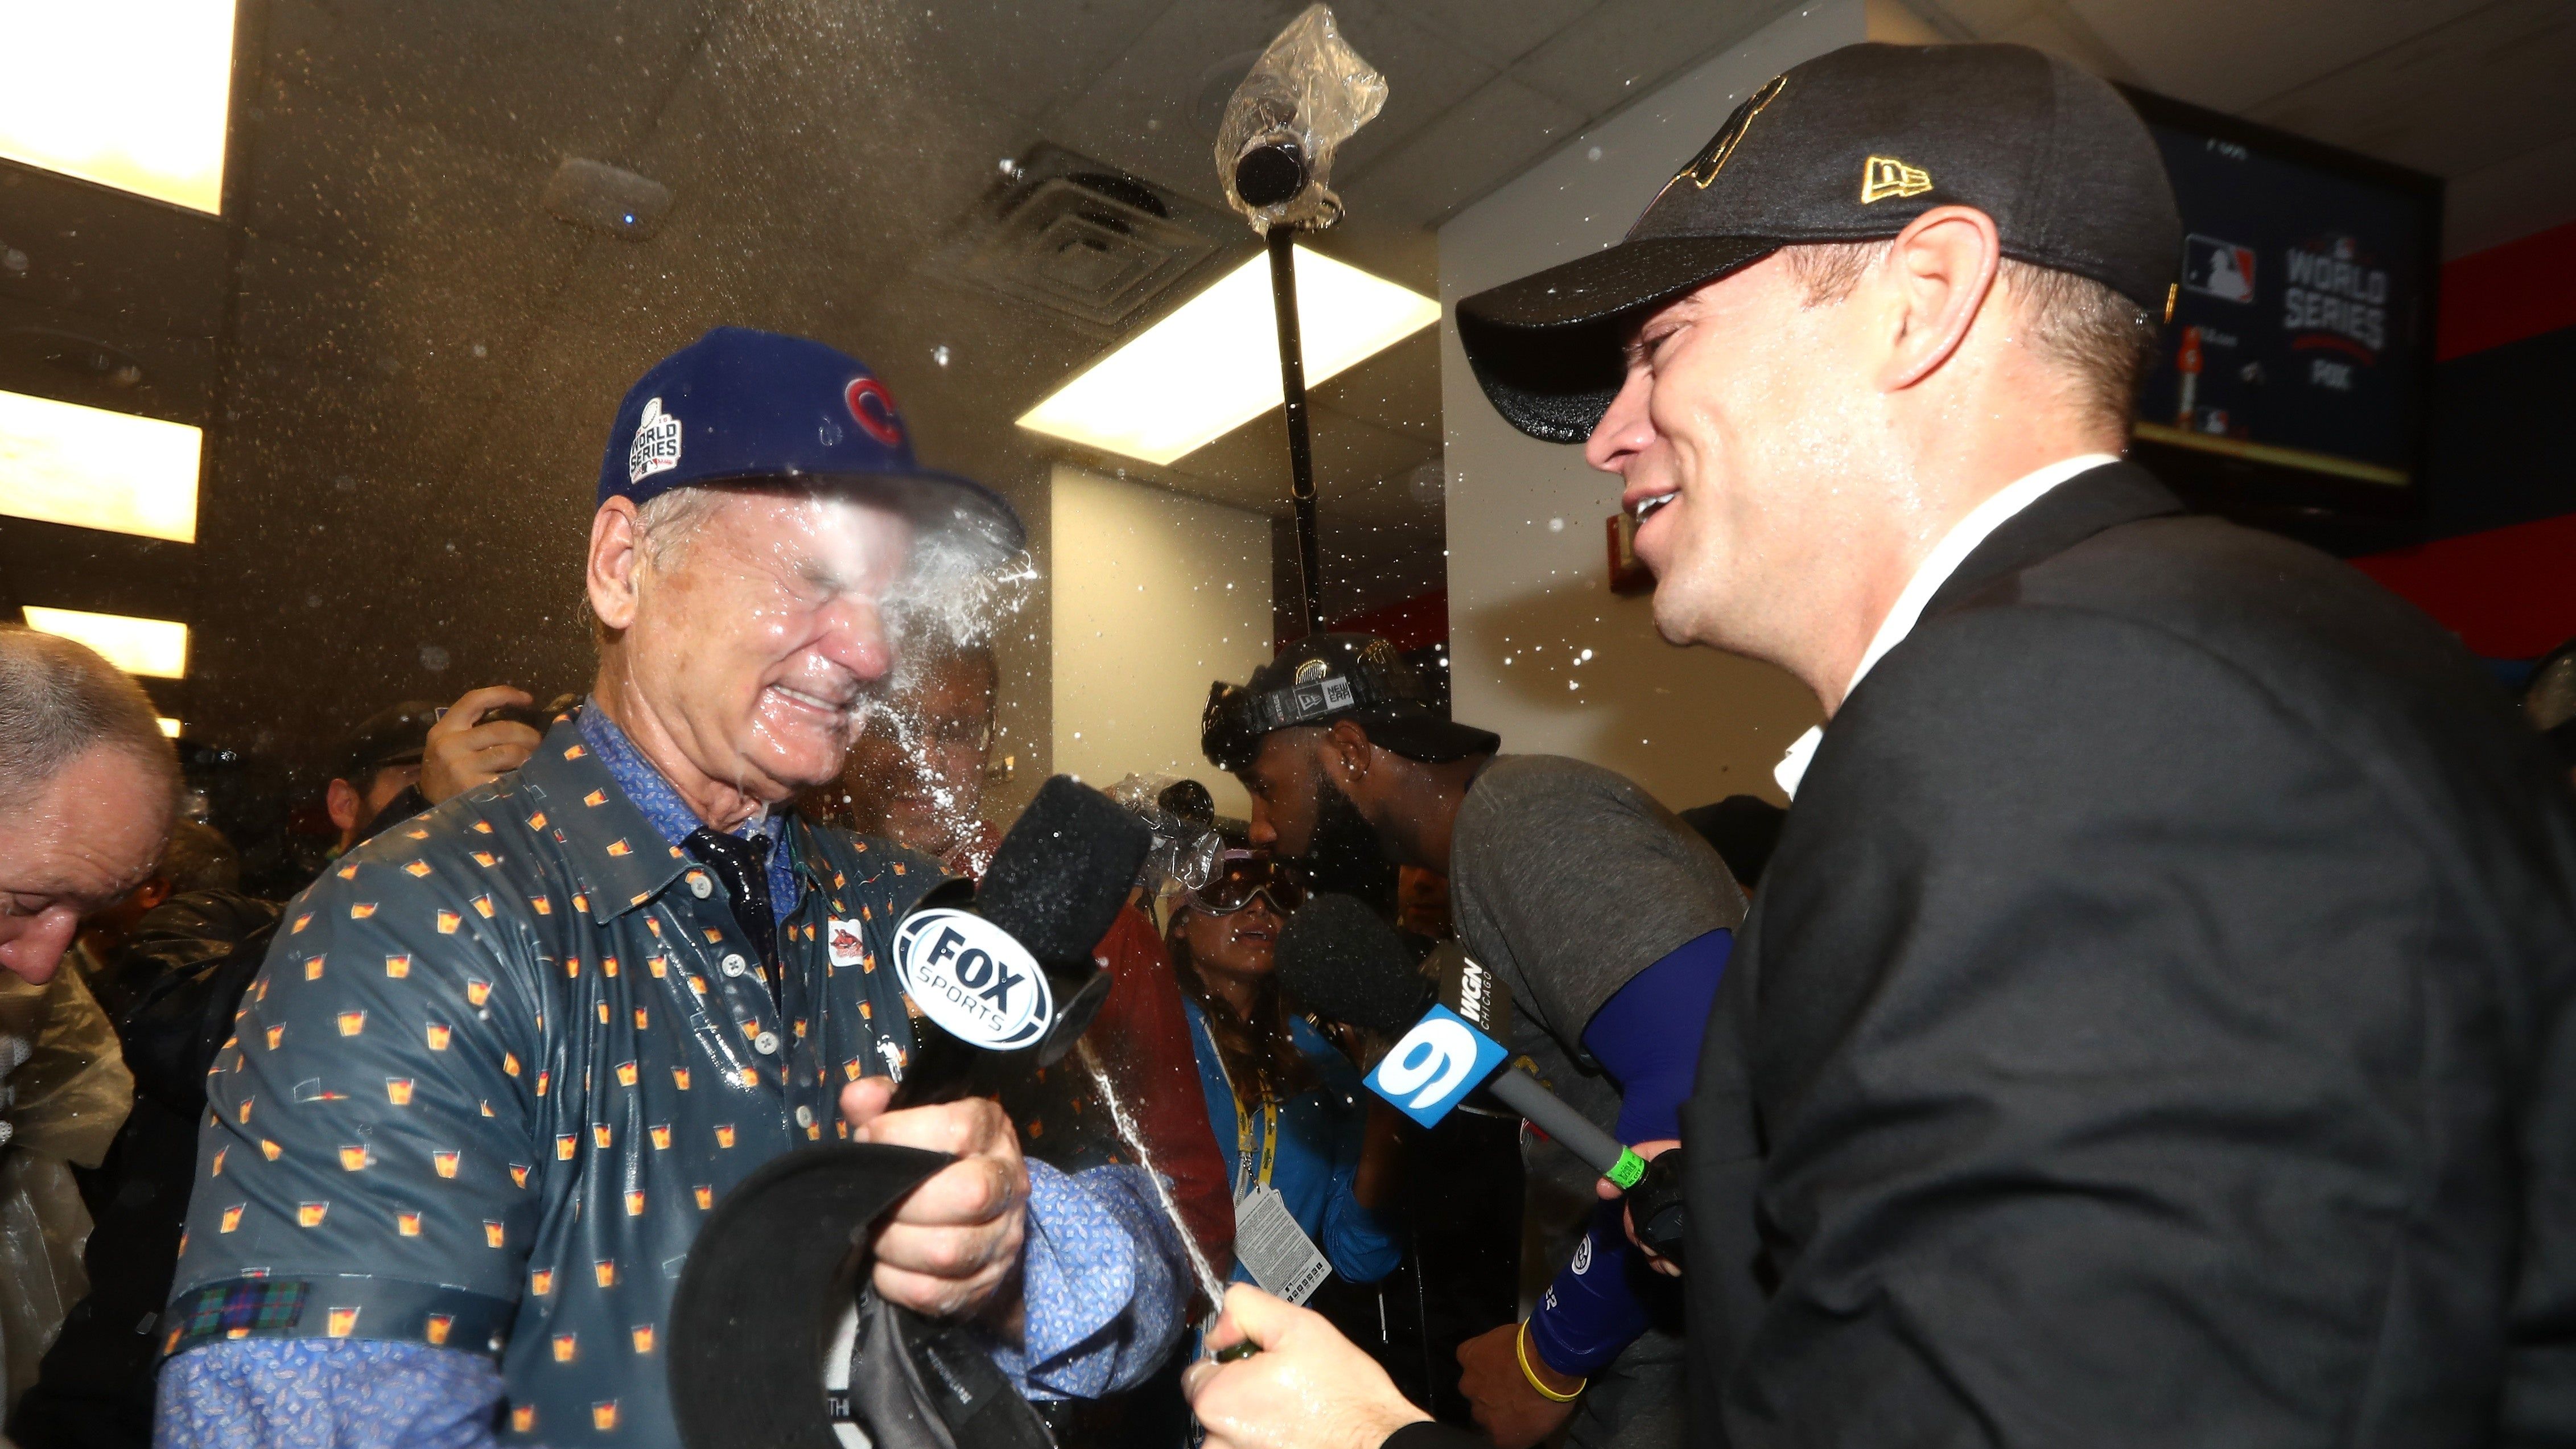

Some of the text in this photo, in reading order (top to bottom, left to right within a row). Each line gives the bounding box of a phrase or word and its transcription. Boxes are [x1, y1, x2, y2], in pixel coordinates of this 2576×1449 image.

[2287, 247, 2387, 304] WORLD
[2284, 286, 2385, 351] SERIES
[632, 423, 676, 455] WORLD
[844, 377, 901, 445] C
[630, 439, 677, 474] SERIES
[1327, 682, 1347, 695] NEW
[1329, 690, 1350, 703] ERA
[916, 966, 1005, 1032] SPORTS
[927, 926, 1026, 1015] FOX
[1460, 957, 1483, 1022] WGN
[1481, 970, 1492, 1031] CHICAGO
[1377, 1018, 1478, 1109] 9
